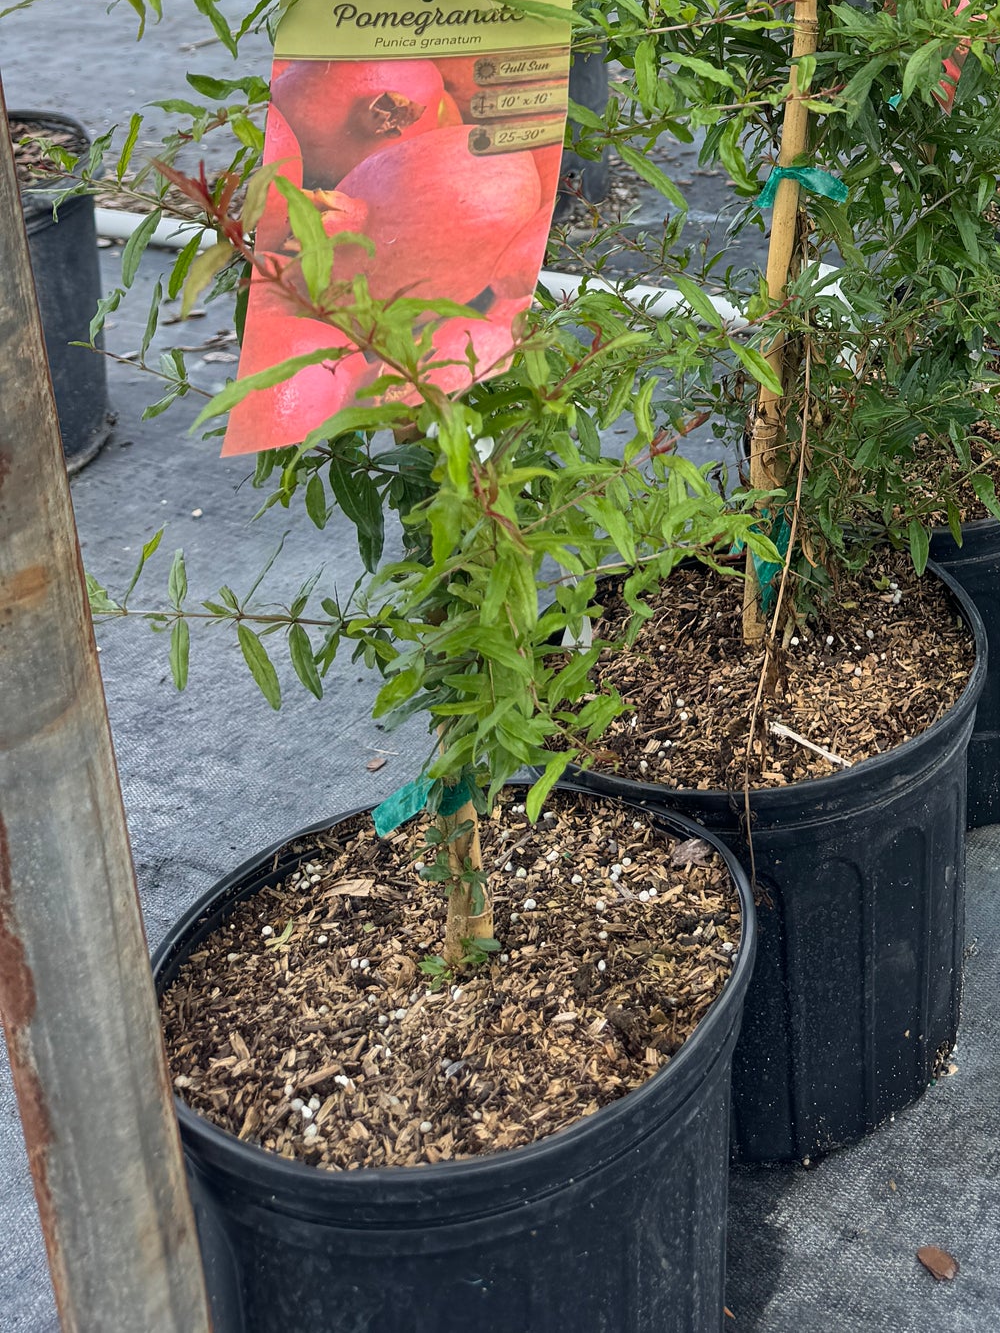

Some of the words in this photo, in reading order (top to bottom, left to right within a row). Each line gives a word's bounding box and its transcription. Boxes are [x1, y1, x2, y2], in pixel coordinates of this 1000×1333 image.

[374, 37, 417, 48] Punica
[420, 35, 482, 49] granatum
[500, 62, 526, 74] Full
[527, 60, 549, 71] Sun
[501, 96, 520, 108] 10'
[523, 97, 531, 105] x
[533, 93, 552, 105] 10'
[498, 129, 545, 144] 25-30°
